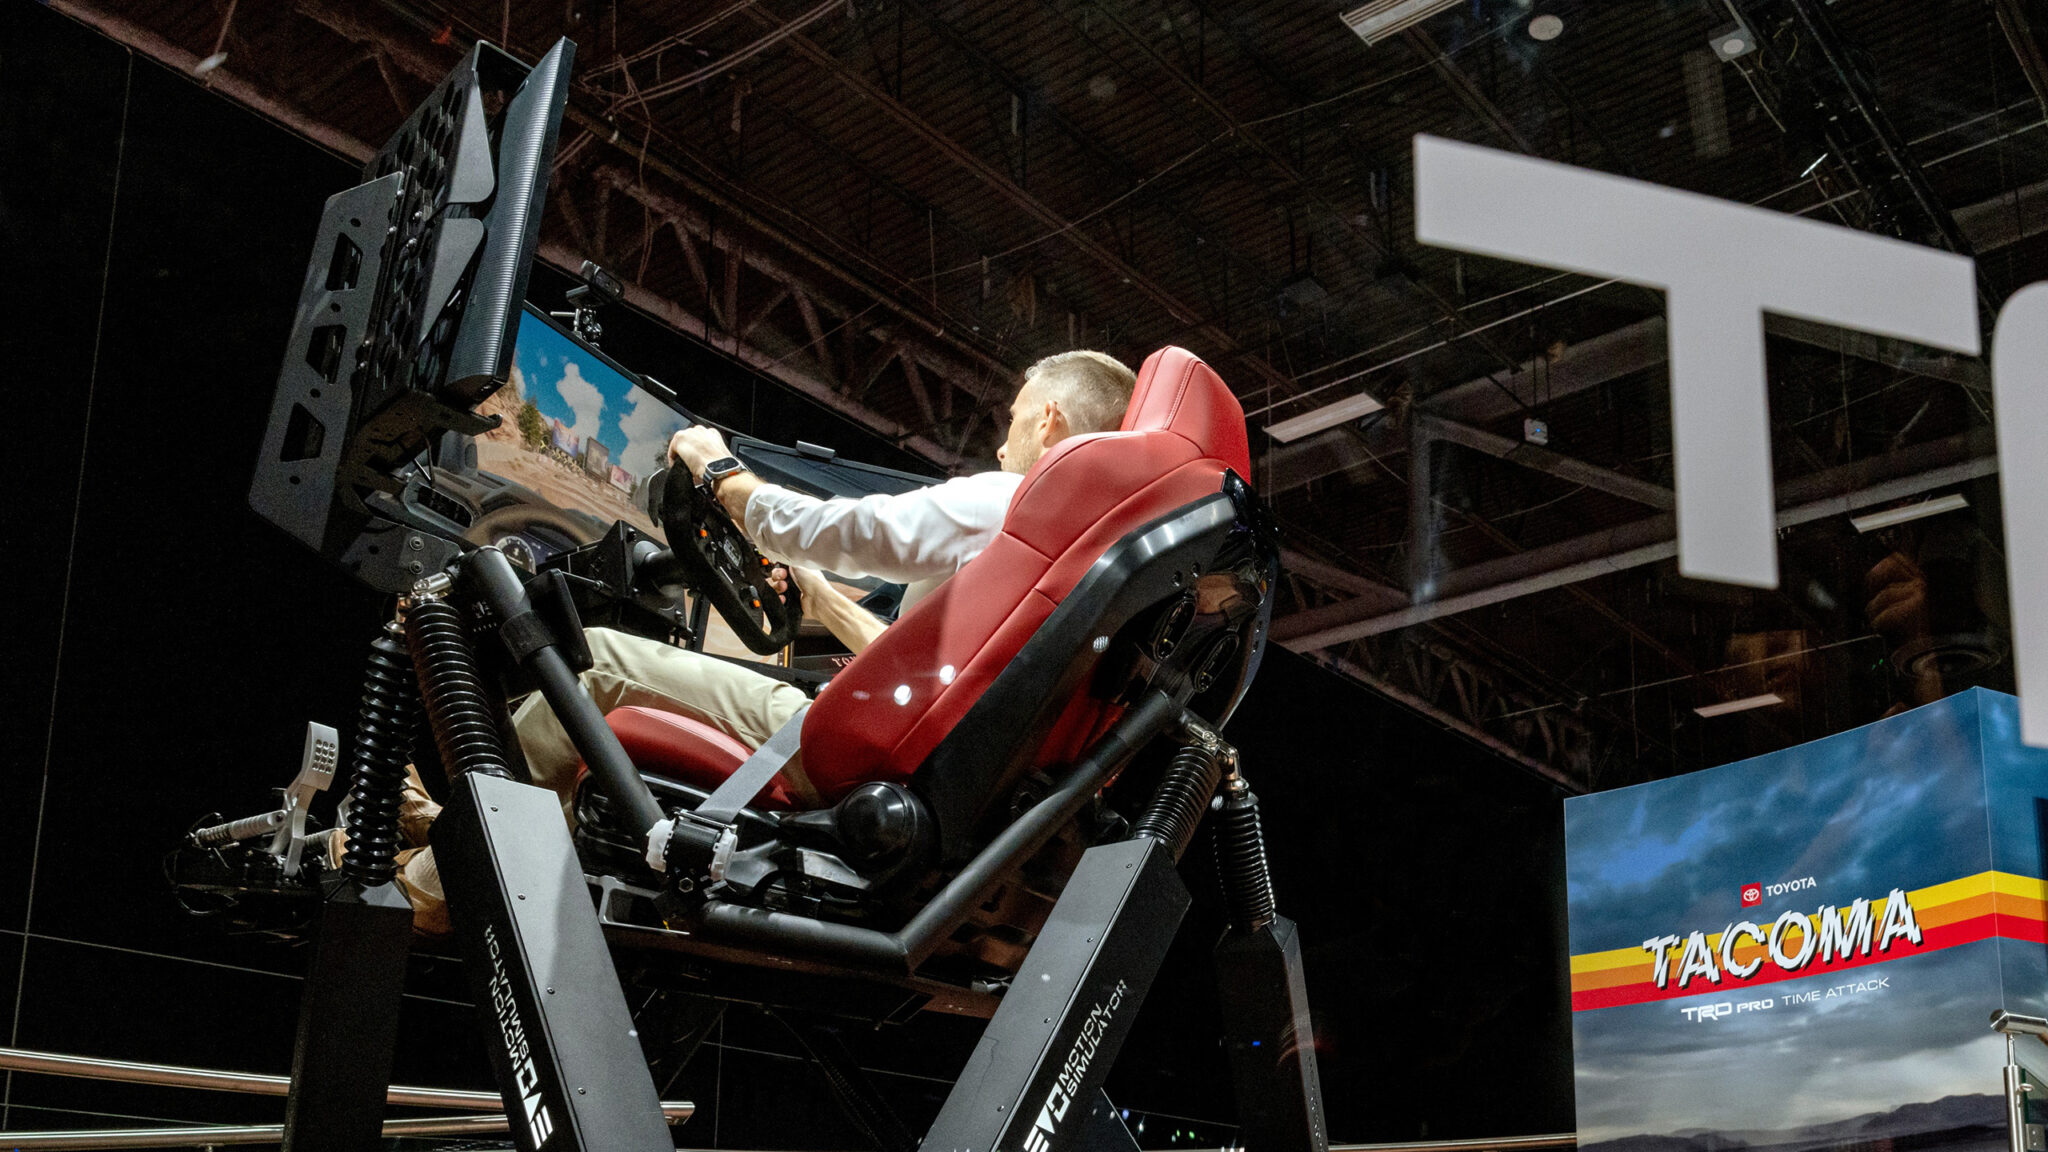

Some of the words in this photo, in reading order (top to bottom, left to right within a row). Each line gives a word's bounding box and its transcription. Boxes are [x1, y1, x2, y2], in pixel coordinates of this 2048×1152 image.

[1766, 876, 1817, 897] TOYOTA
[1642, 887, 1923, 990] TACOMA
[485, 924, 530, 1060] SIMULATOR
[489, 975, 521, 1071] MOTION
[1066, 978, 1128, 1098] SIMULATOR
[1681, 1002, 1732, 1023] TRD
[1736, 998, 1774, 1014] PRO
[1781, 990, 1821, 1006] TIME
[1825, 977, 1890, 999] ATTACK
[1058, 1002, 1102, 1087] MOTION
